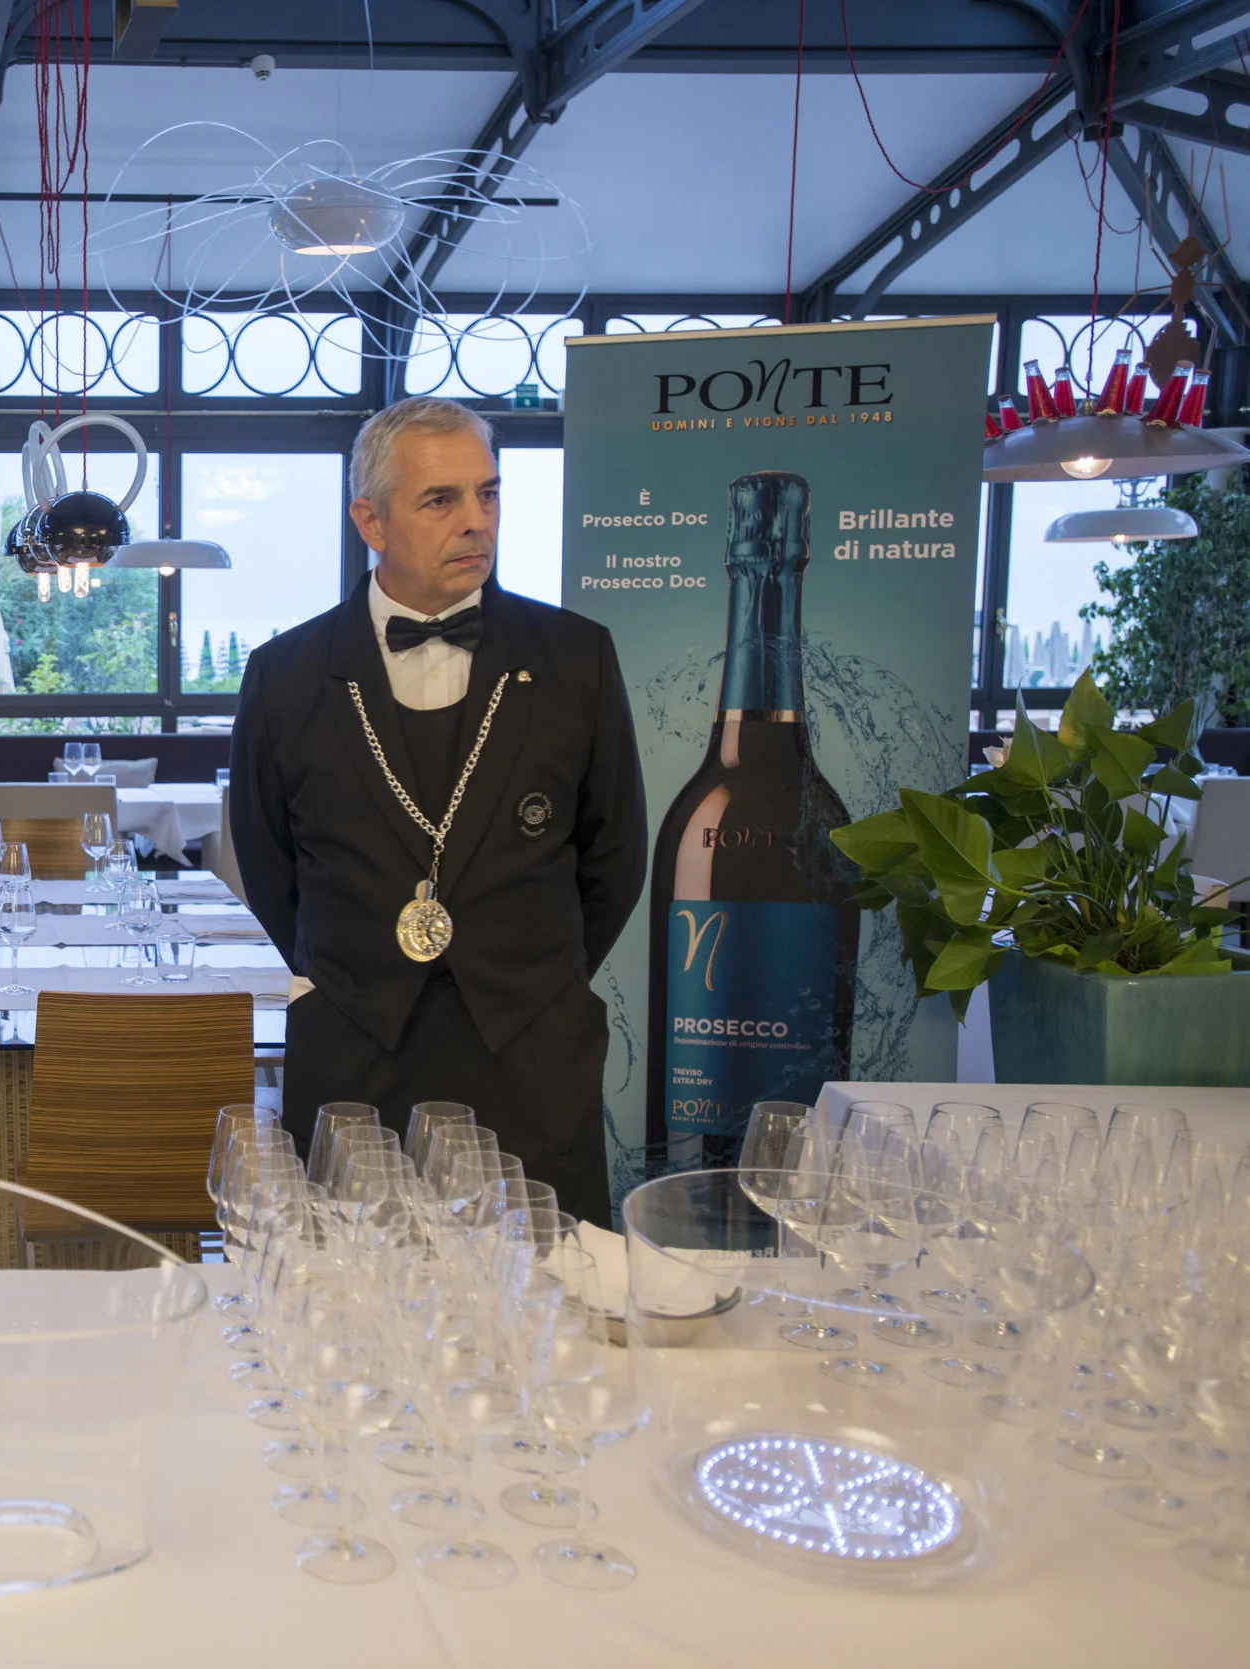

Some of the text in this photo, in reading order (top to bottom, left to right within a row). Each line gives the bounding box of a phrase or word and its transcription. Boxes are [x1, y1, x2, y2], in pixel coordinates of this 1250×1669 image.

[652, 358, 894, 414] PONTE
[651, 411, 893, 431] UOMINI E VIGNE DAL 1948
[639, 489, 651, 505] È
[582, 512, 708, 528] Prosecco Doc
[839, 508, 955, 530] Brillante
[834, 540, 956, 560] di natura
[606, 554, 682, 568] Il nostro
[581, 574, 706, 590] Prosecco Doc
[673, 1017, 789, 1037] PROSECCO
[673, 1067, 703, 1076] TREVISO
[673, 1076, 714, 1086] EXTRA DRY
